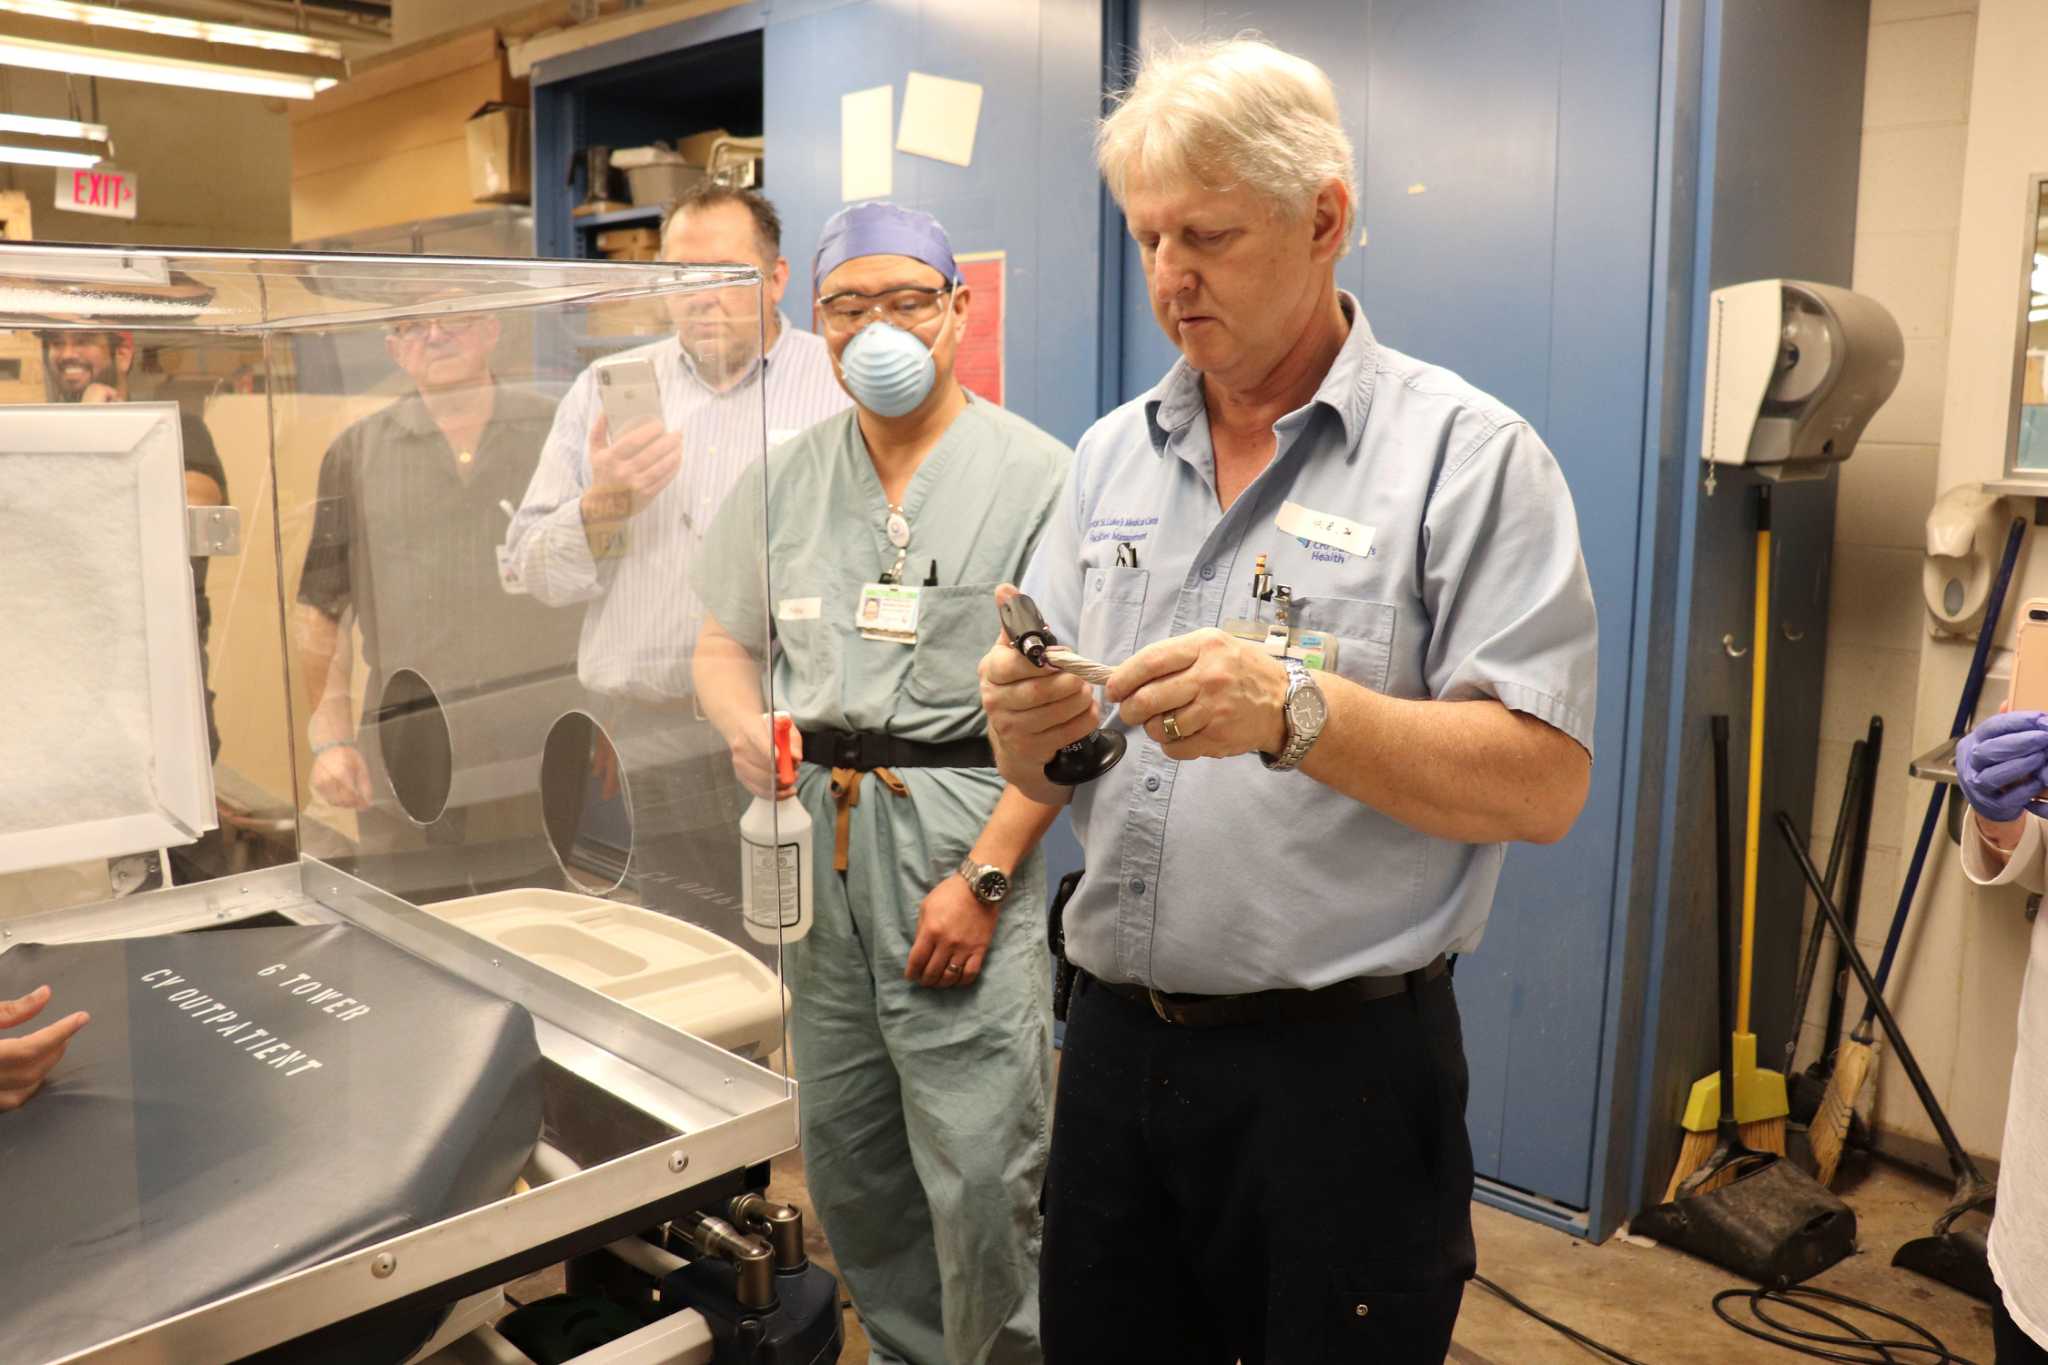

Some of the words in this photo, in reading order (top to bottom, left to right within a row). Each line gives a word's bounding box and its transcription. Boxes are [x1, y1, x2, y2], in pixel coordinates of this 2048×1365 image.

[72, 169, 124, 208] EXIT
[1312, 551, 1345, 564] Health
[257, 963, 287, 977] 6
[278, 972, 372, 1022] TOWER
[140, 968, 186, 990] CV
[167, 987, 323, 1078] OUTPATIENT
